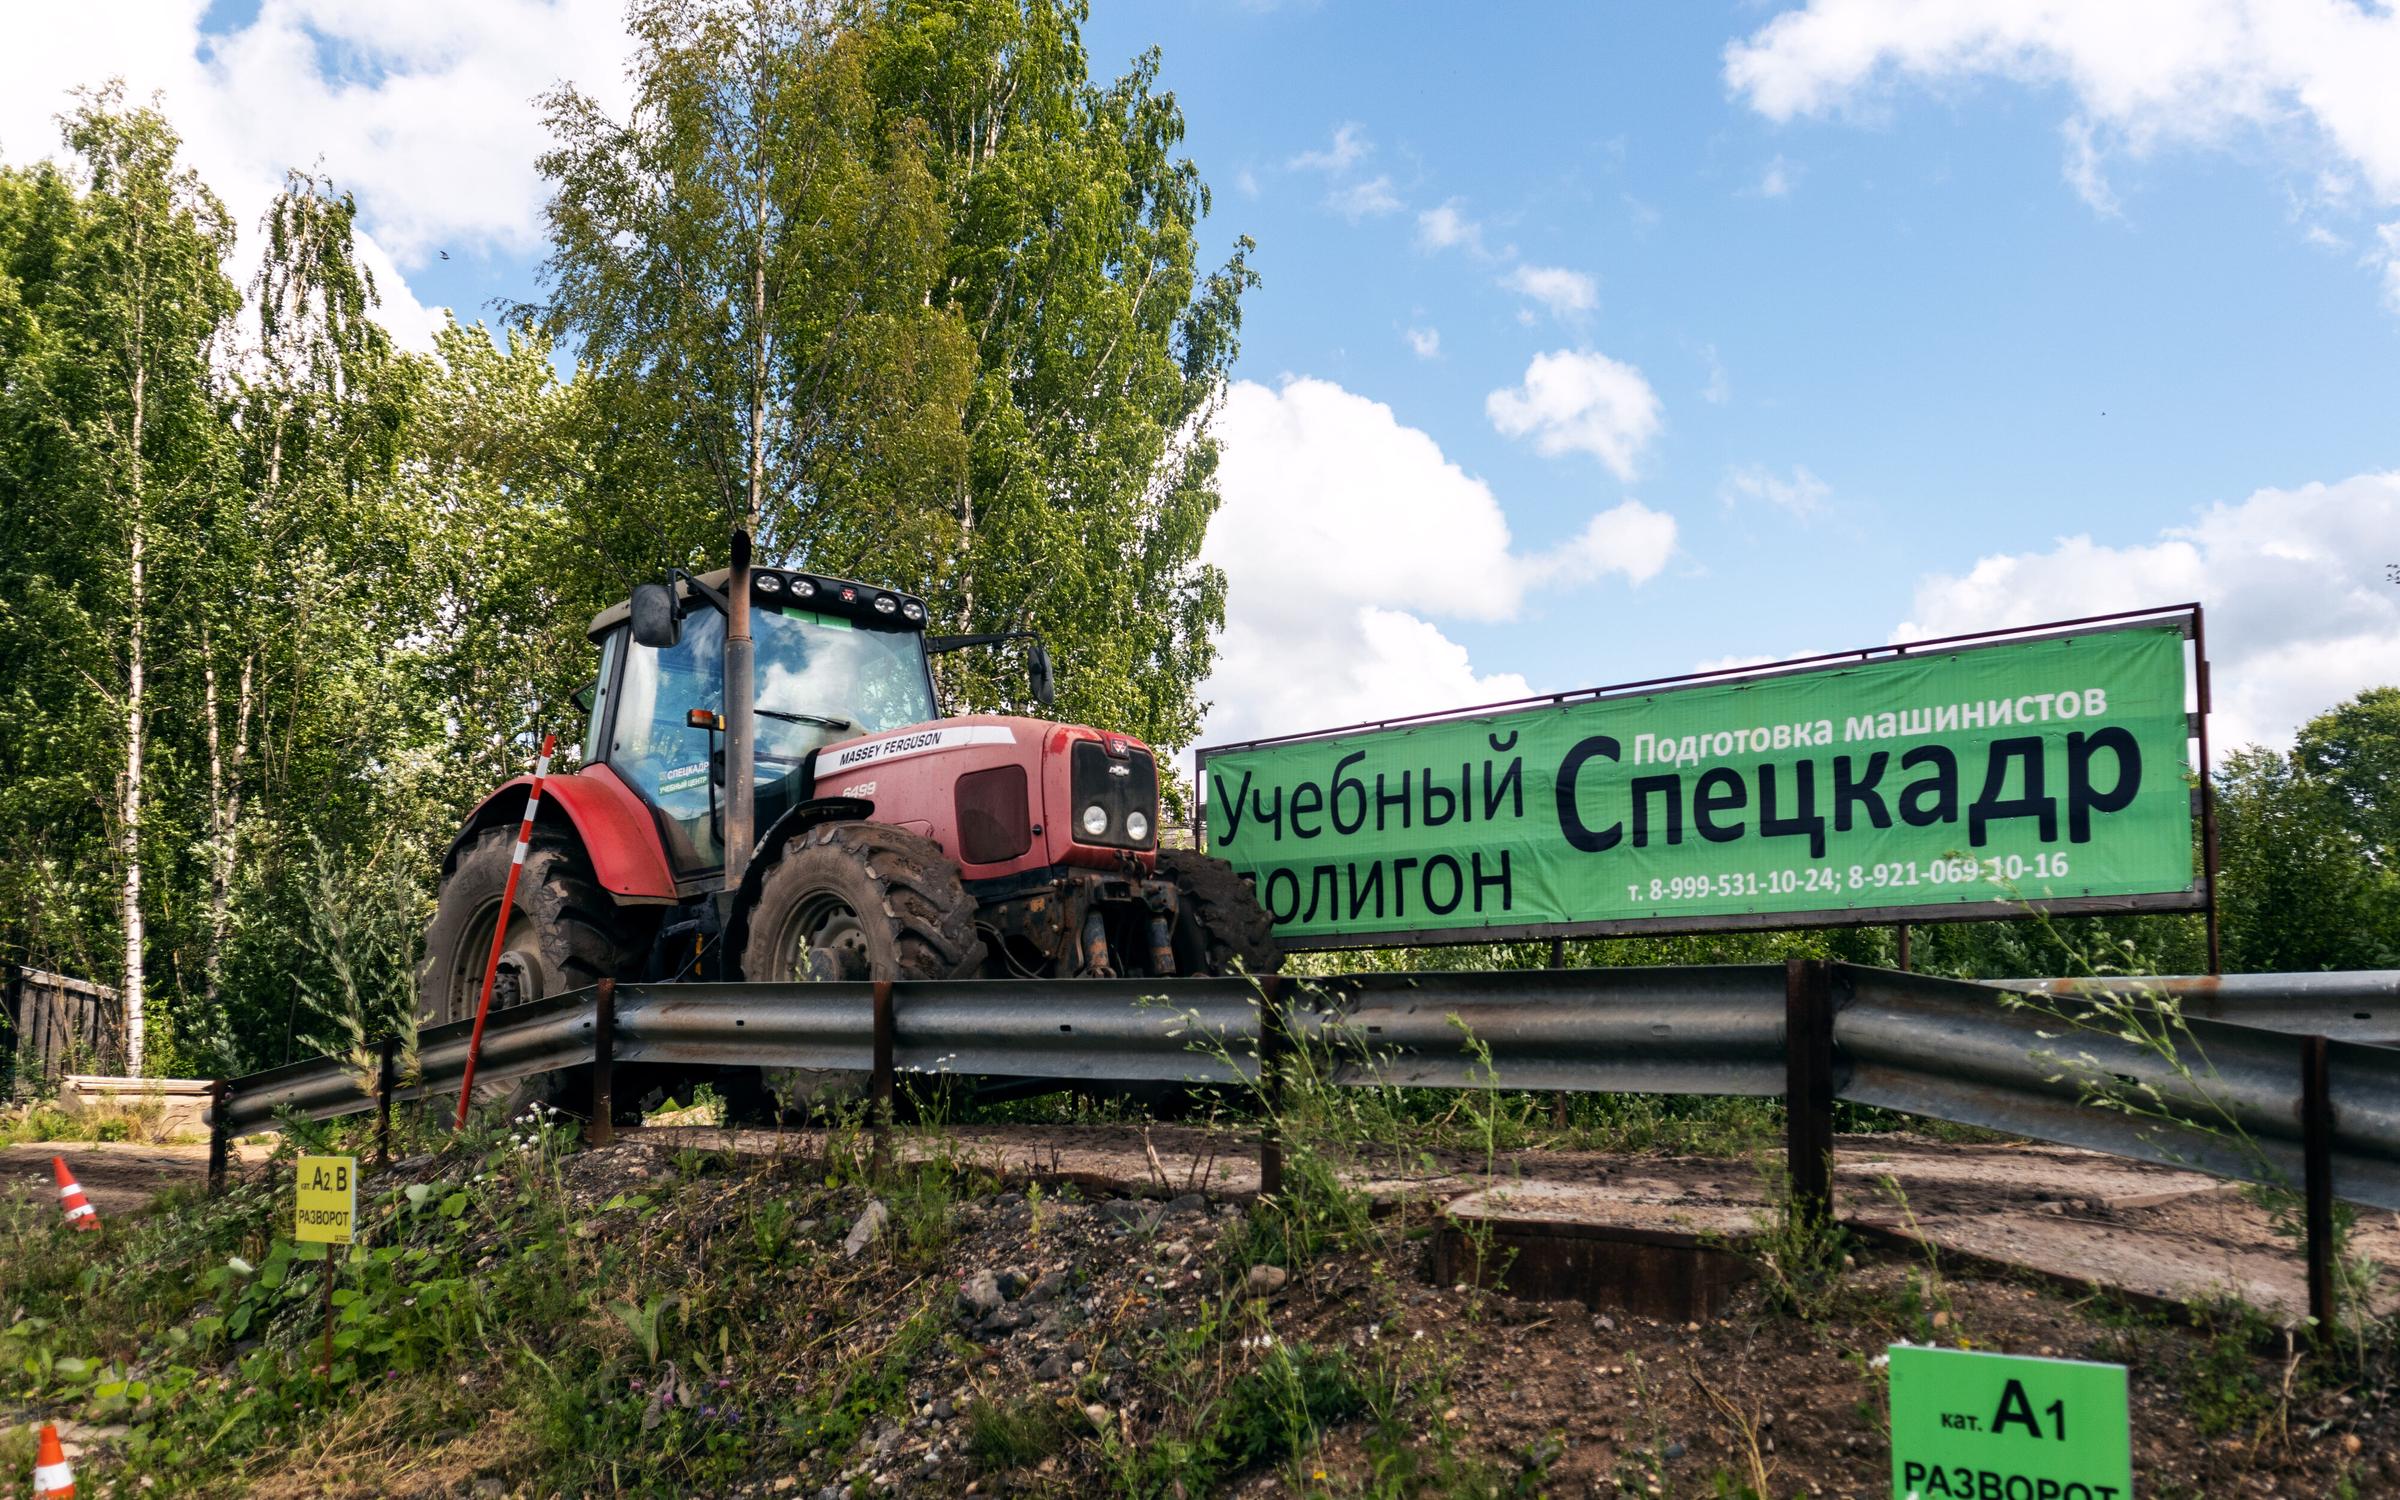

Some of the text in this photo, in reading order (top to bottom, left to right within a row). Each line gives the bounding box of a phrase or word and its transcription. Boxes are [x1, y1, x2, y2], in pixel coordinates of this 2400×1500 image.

[839, 732, 942, 766] MASSEY FERGUSON
[1633, 688, 2108, 769] Подготовка машинистов
[842, 781, 877, 799] 6499
[1213, 730, 1525, 847] Учебный
[1554, 726, 2143, 859] Спецкадр
[1238, 850, 1513, 925] олигон
[1649, 867, 1842, 901] 8-999-531-10-24;
[1848, 851, 2070, 889] 8-921-069-10-16
[298, 1209, 349, 1227] РАЗВОРОТ
[1940, 1412, 1983, 1432] кат.
